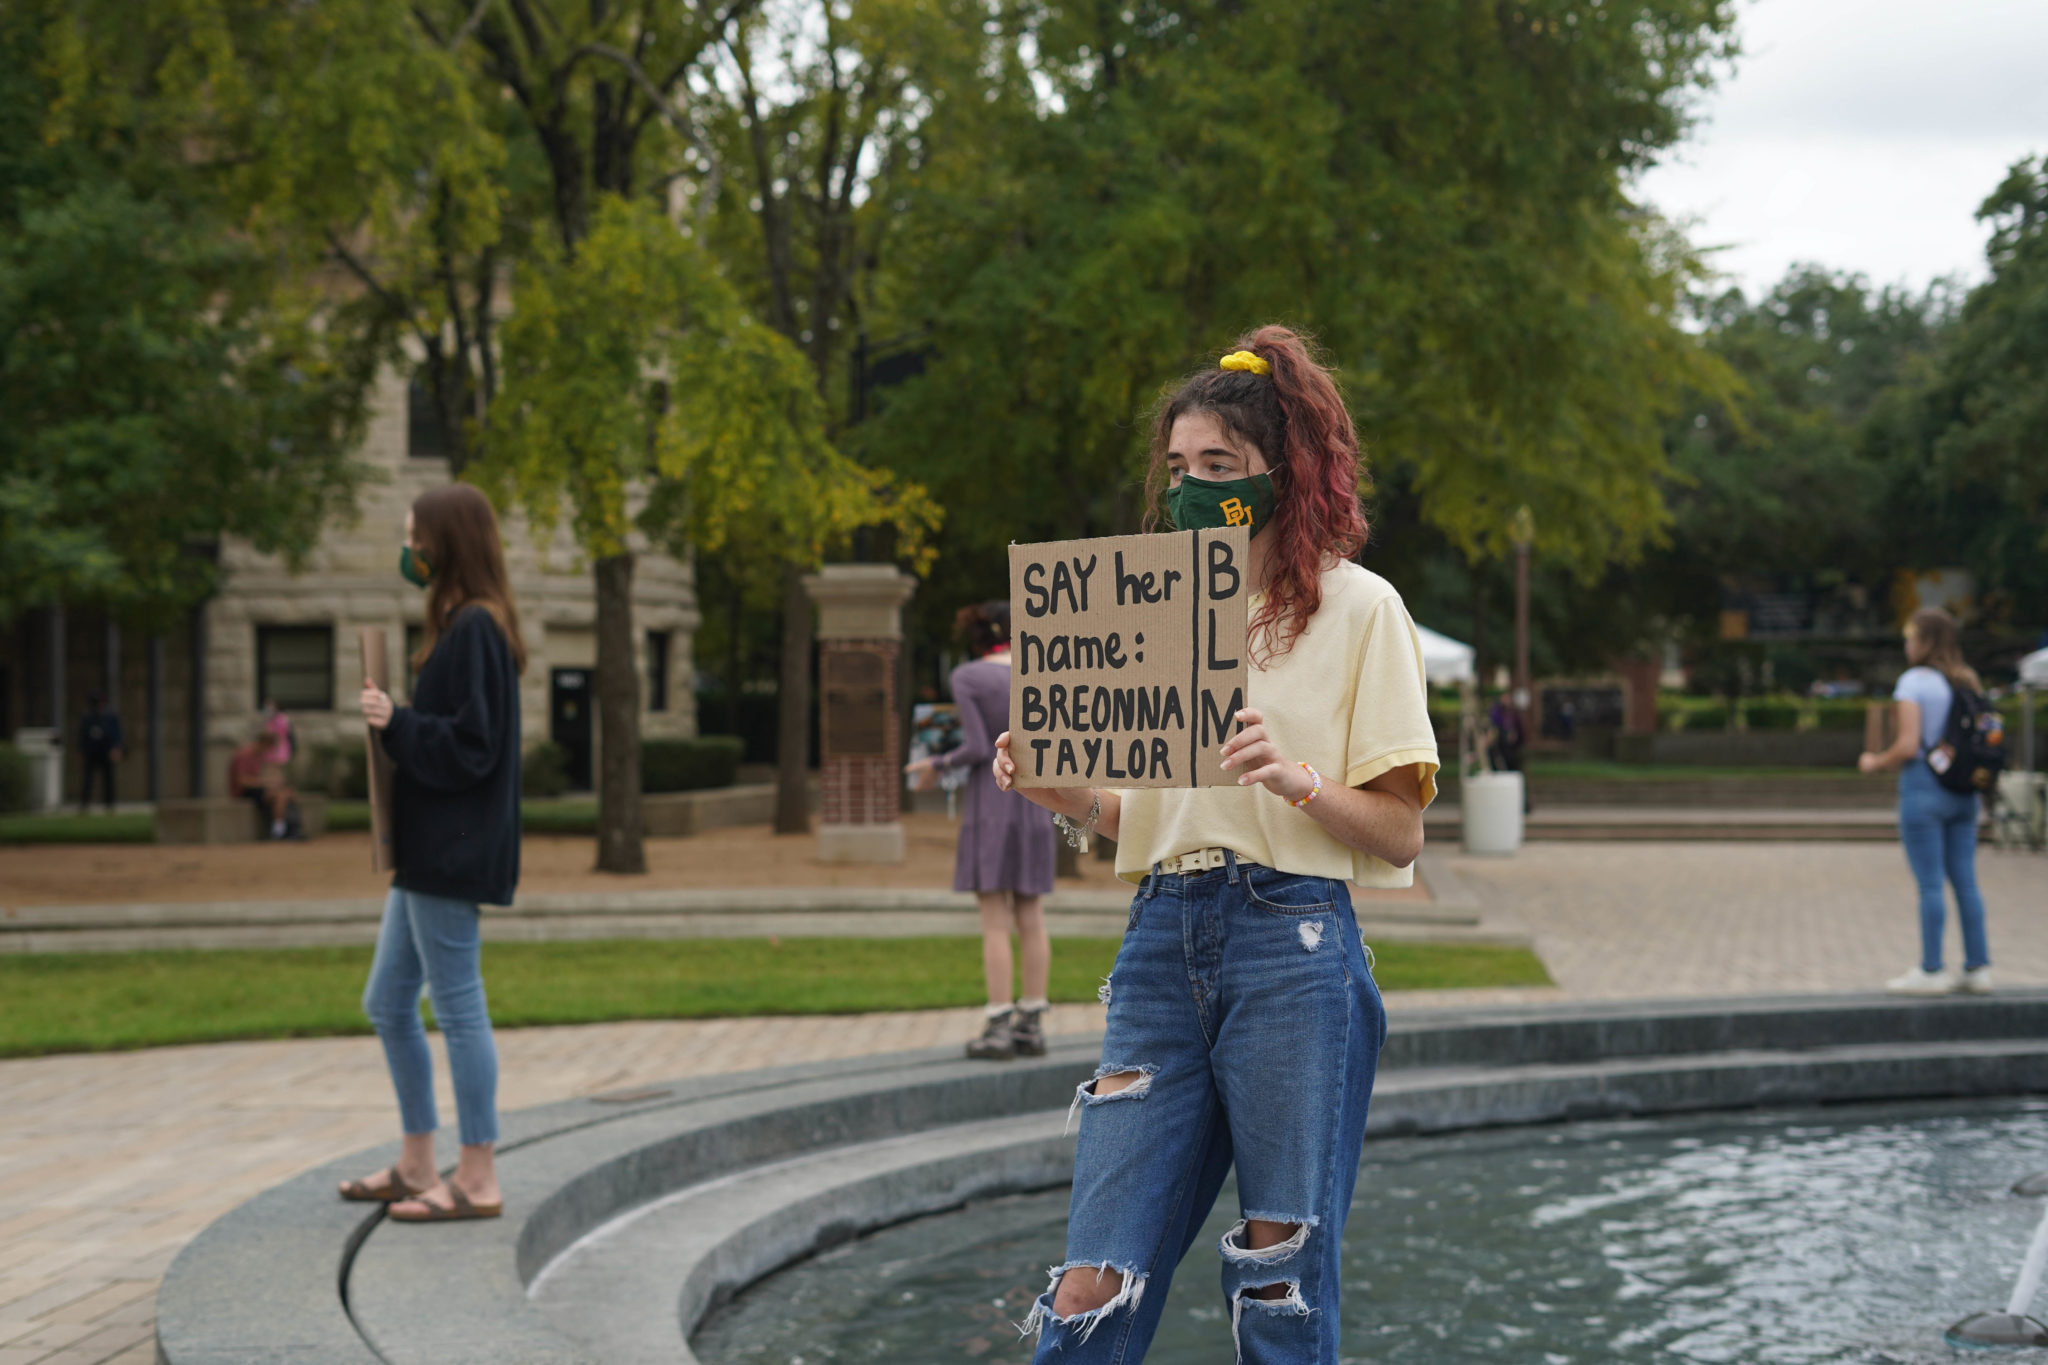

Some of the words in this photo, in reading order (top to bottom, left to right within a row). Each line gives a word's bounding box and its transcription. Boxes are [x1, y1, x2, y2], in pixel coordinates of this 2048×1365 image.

[1023, 553, 1097, 618] SAY
[1114, 550, 1182, 605] her
[1020, 630, 1145, 676] name:
[1022, 684, 1185, 732] BREONNA
[1030, 737, 1173, 779] TAYLOR
